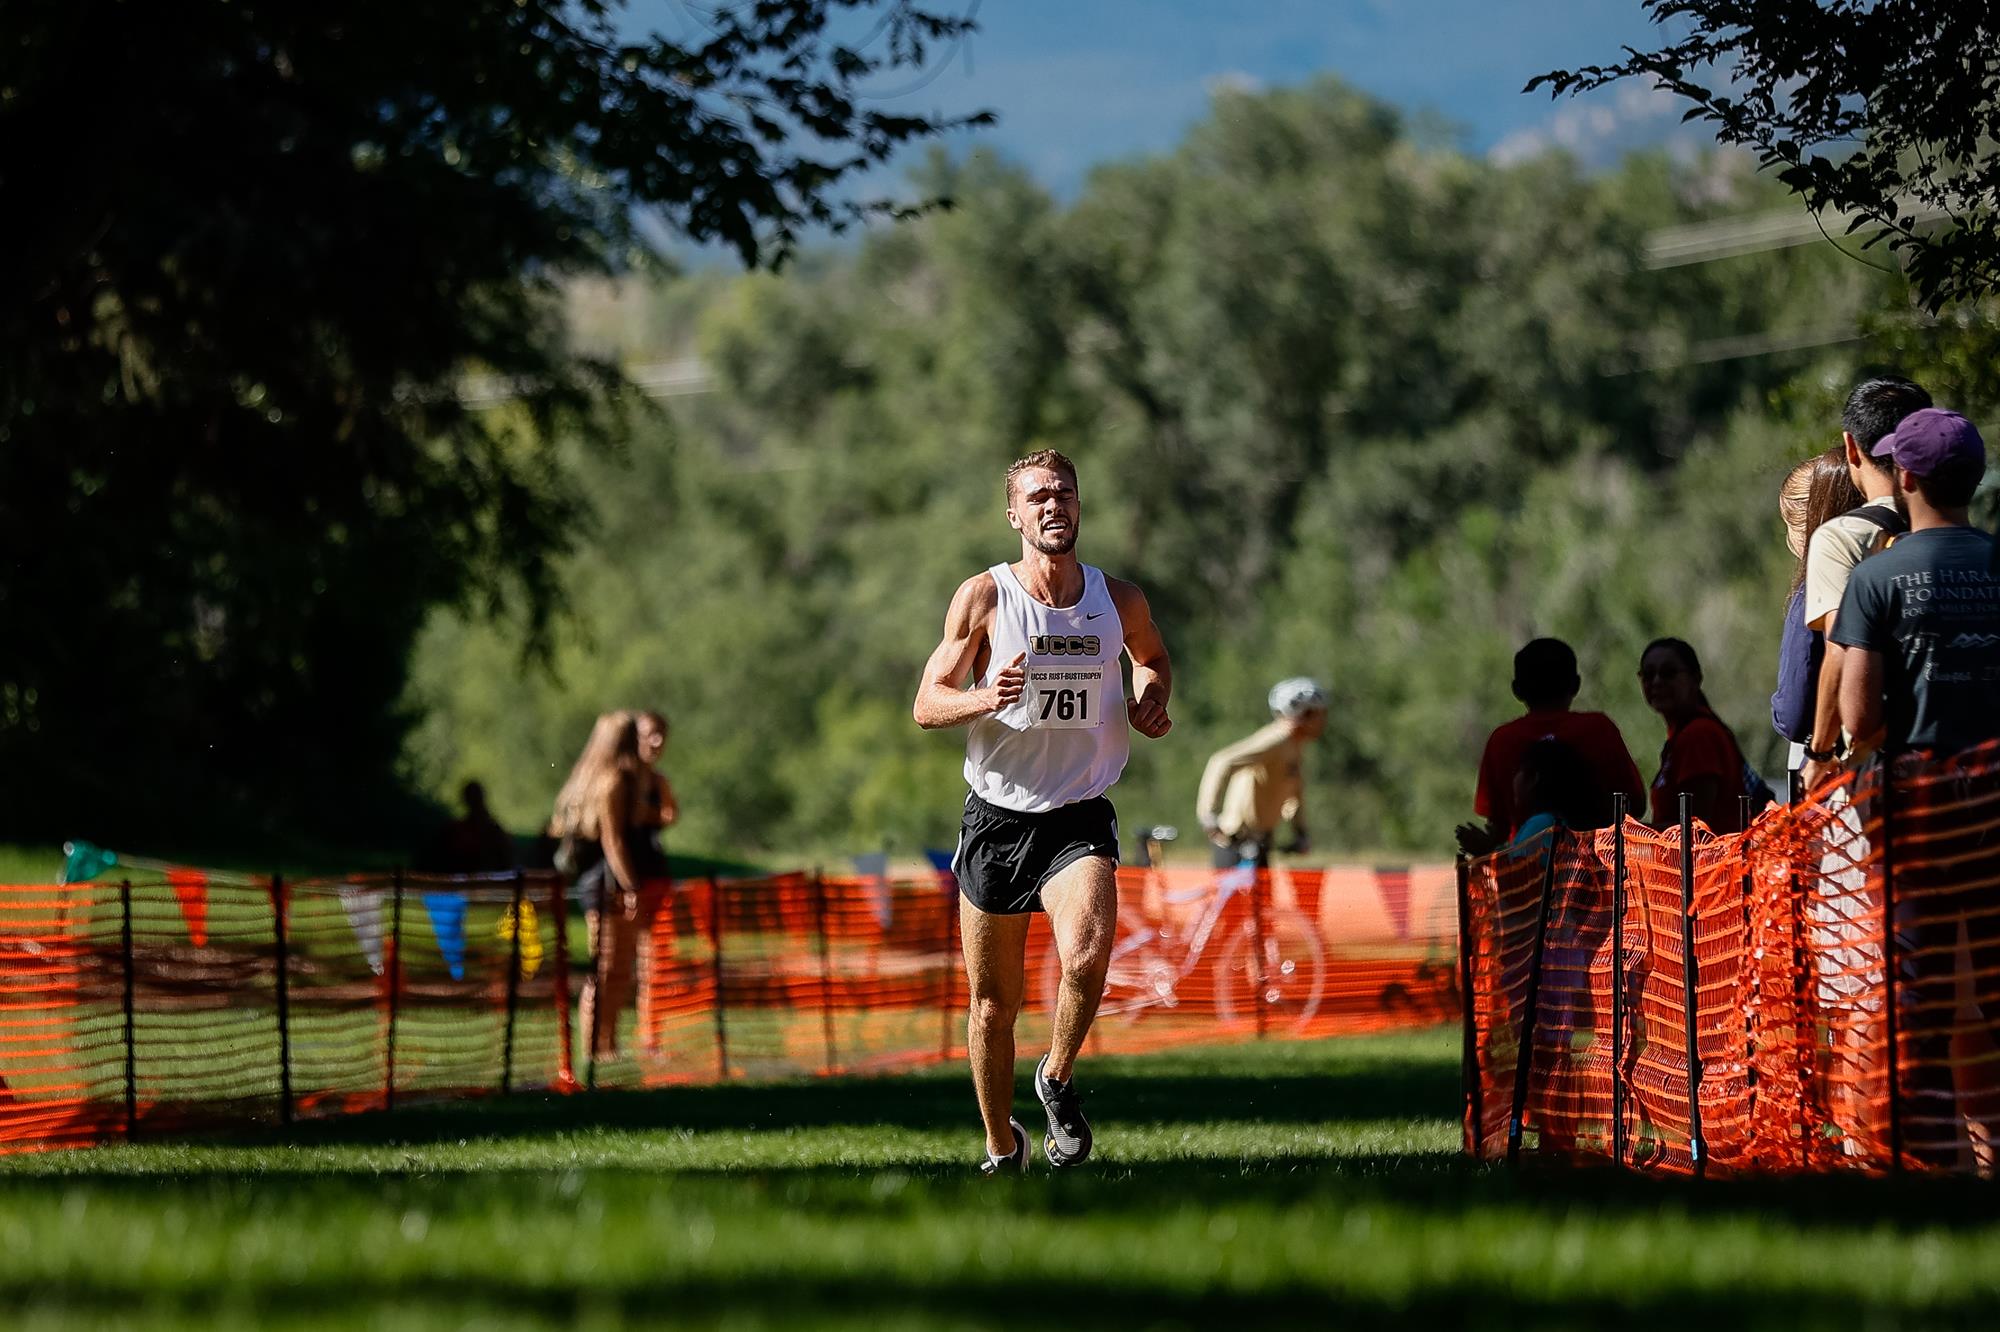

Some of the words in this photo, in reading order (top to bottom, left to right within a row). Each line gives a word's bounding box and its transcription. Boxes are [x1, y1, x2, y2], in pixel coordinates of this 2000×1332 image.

[1891, 571, 1934, 589] THE
[1030, 635, 1101, 655] UCCS
[1031, 672, 1048, 680] UCCS
[1039, 689, 1088, 720] 761
